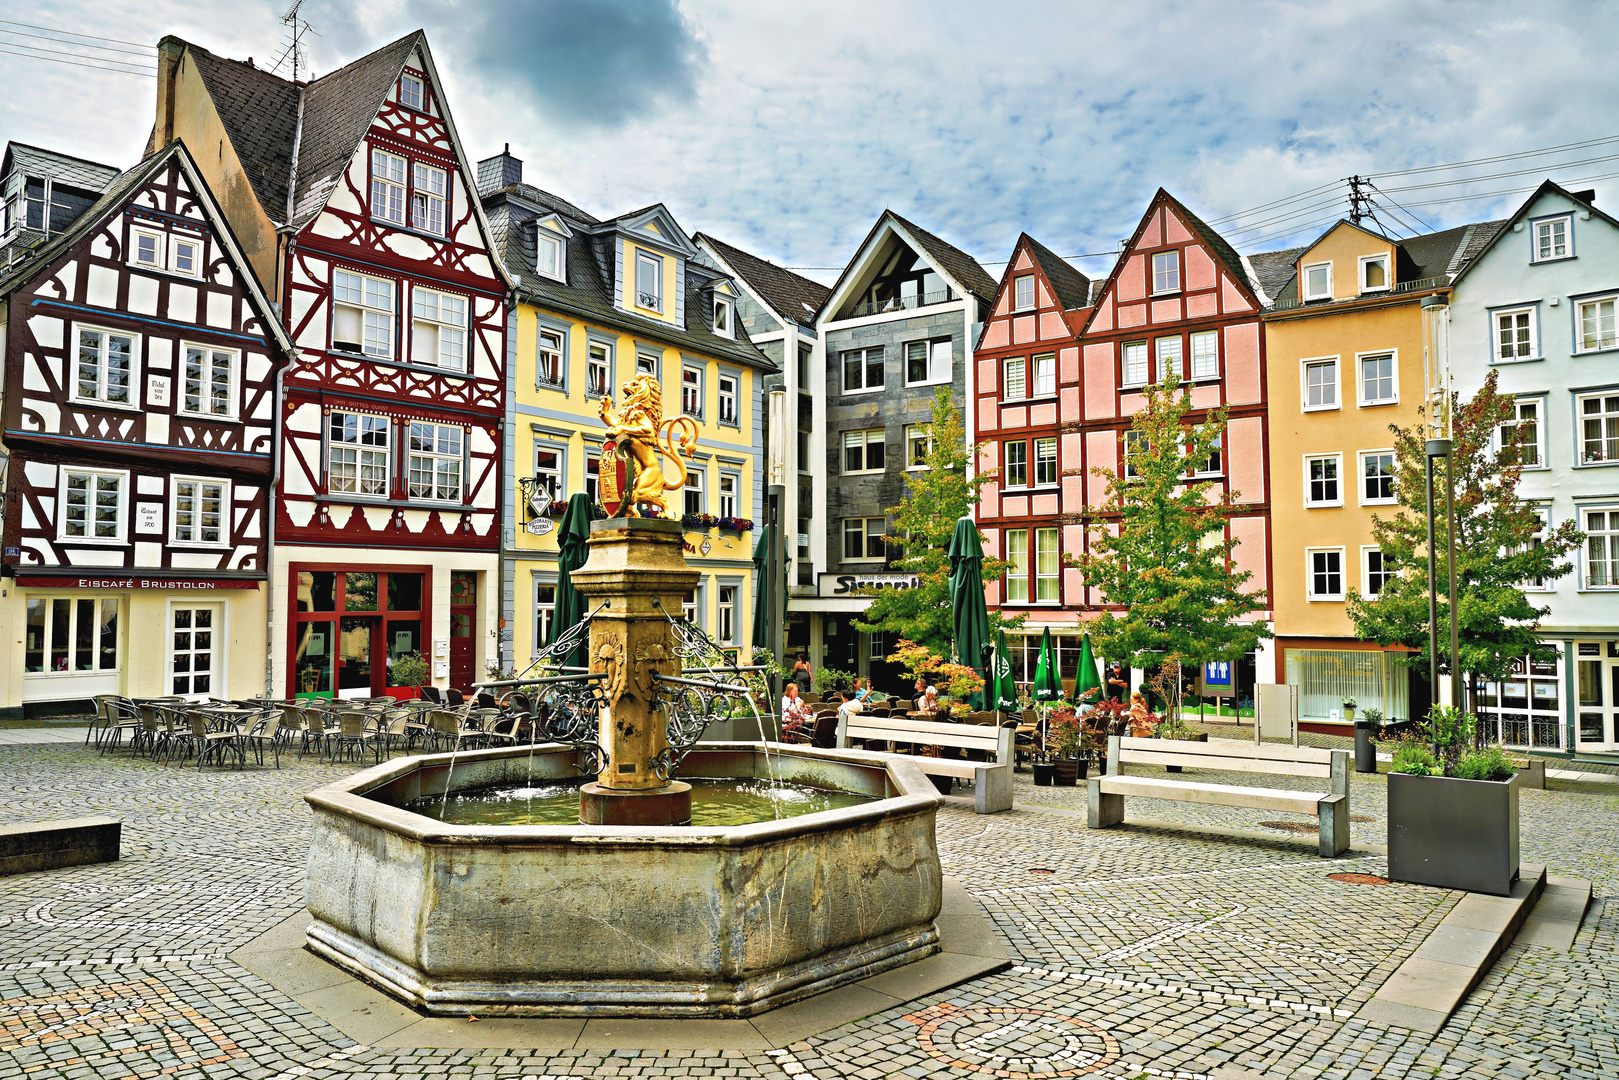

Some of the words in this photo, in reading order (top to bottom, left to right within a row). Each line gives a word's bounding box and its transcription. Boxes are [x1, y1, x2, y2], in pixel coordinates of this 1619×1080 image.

[141, 580, 215, 589] BRUSTOLON
[1294, 655, 1339, 664] KOSMETIK
[1336, 660, 1344, 668] &
